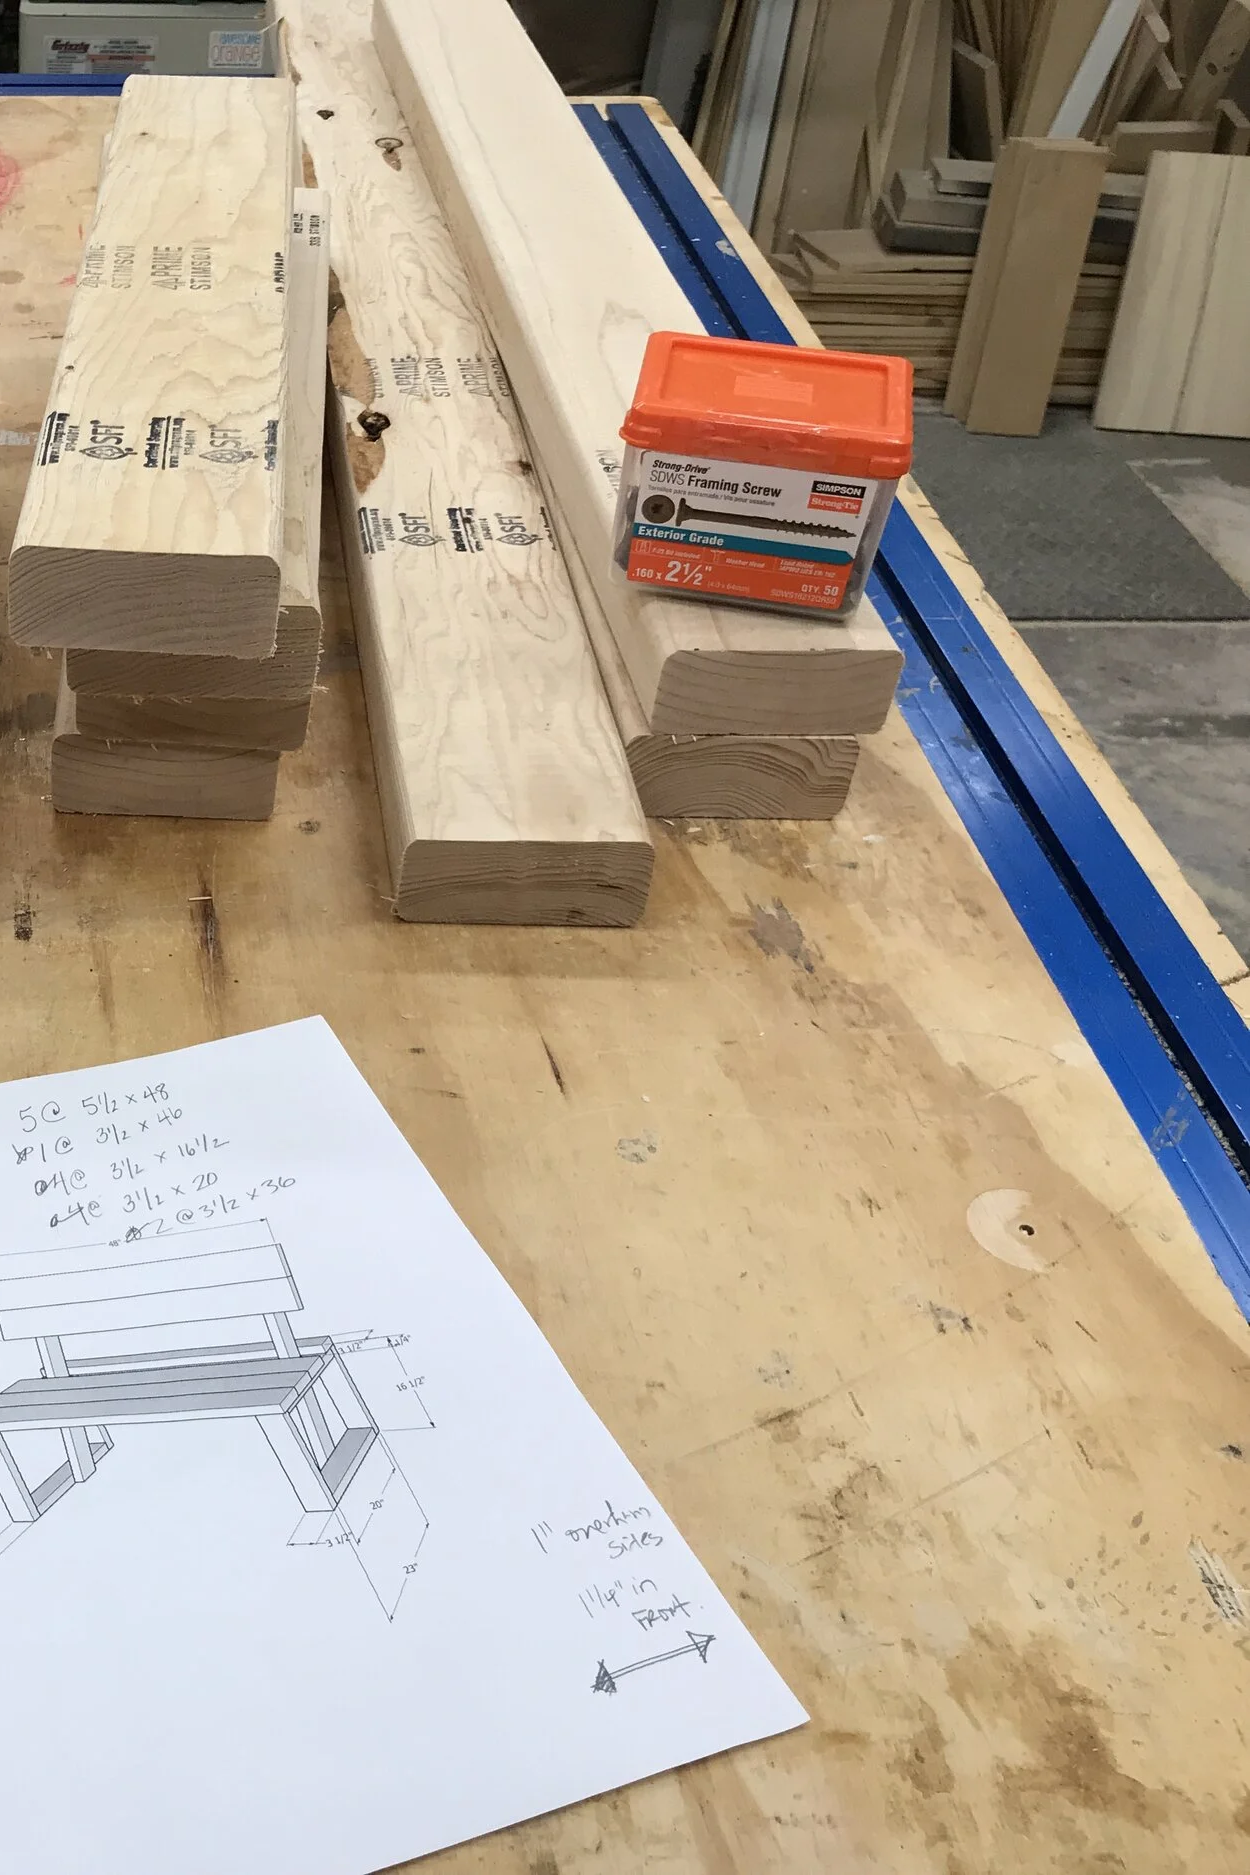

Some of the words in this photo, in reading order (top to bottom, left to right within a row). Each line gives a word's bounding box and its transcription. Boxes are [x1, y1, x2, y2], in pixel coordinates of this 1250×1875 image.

[111, 245, 135, 290] STIMSON
[189, 246, 211, 291] STIMSON
[424, 357, 451, 397] STIMSON
[90, 420, 125, 446] SFI
[208, 425, 242, 448] SFI
[653, 460, 708, 474] Strong-Drive
[650, 470, 685, 485] SDWS
[688, 475, 739, 494] Framing
[743, 482, 782, 498] Screw
[816, 484, 862, 495] SIMPSON
[398, 512, 431, 533] SFI
[494, 513, 527, 533] SFI
[638, 526, 685, 541] Exterior
[689, 533, 724, 546] Grade
[632, 568, 653, 579] .160
[823, 585, 839, 596] 50
[143, 1082, 169, 1104] 48
[157, 1107, 183, 1126] 46
[192, 1172, 218, 1192] 20
[261, 1176, 296, 1194] 36
[396, 1382, 408, 1392] 16
[326, 1539, 333, 1548] 3
[632, 1577, 658, 1595] in
